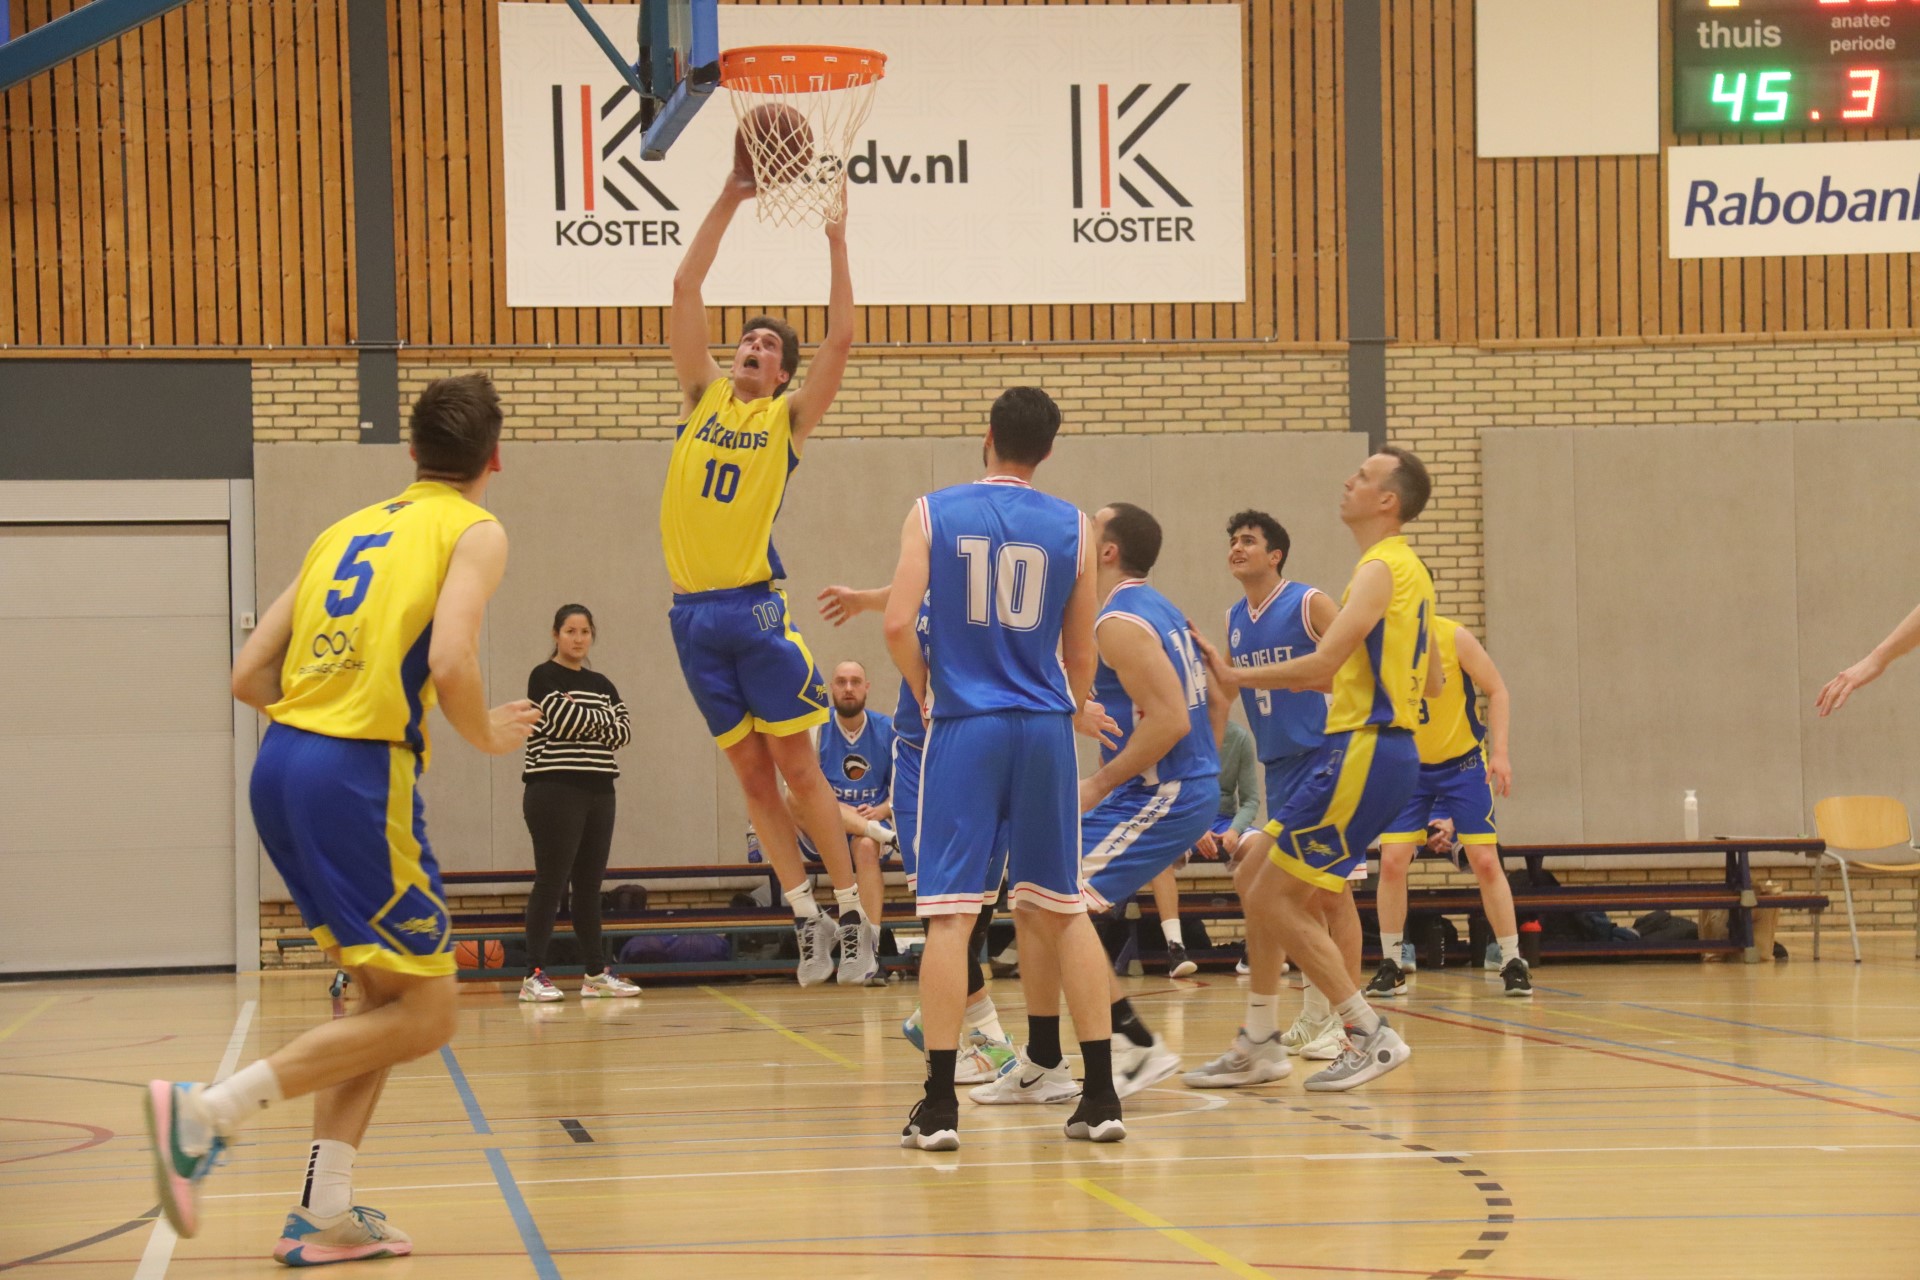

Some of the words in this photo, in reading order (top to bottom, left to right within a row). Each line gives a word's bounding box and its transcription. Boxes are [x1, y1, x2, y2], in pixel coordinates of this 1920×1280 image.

[1697, 20, 1782, 49] thuis
[1831, 14, 1891, 29] anatec
[1830, 36, 1896, 54] periode
[1711, 71, 1792, 122] 45
[800, 140, 969, 184] adv.nl
[556, 214, 682, 246] KÖSTER
[1073, 212, 1196, 243] KÖSTER
[701, 458, 741, 504] 10
[324, 531, 394, 618] 5
[957, 535, 1048, 632] 10
[752, 601, 780, 631] 10
